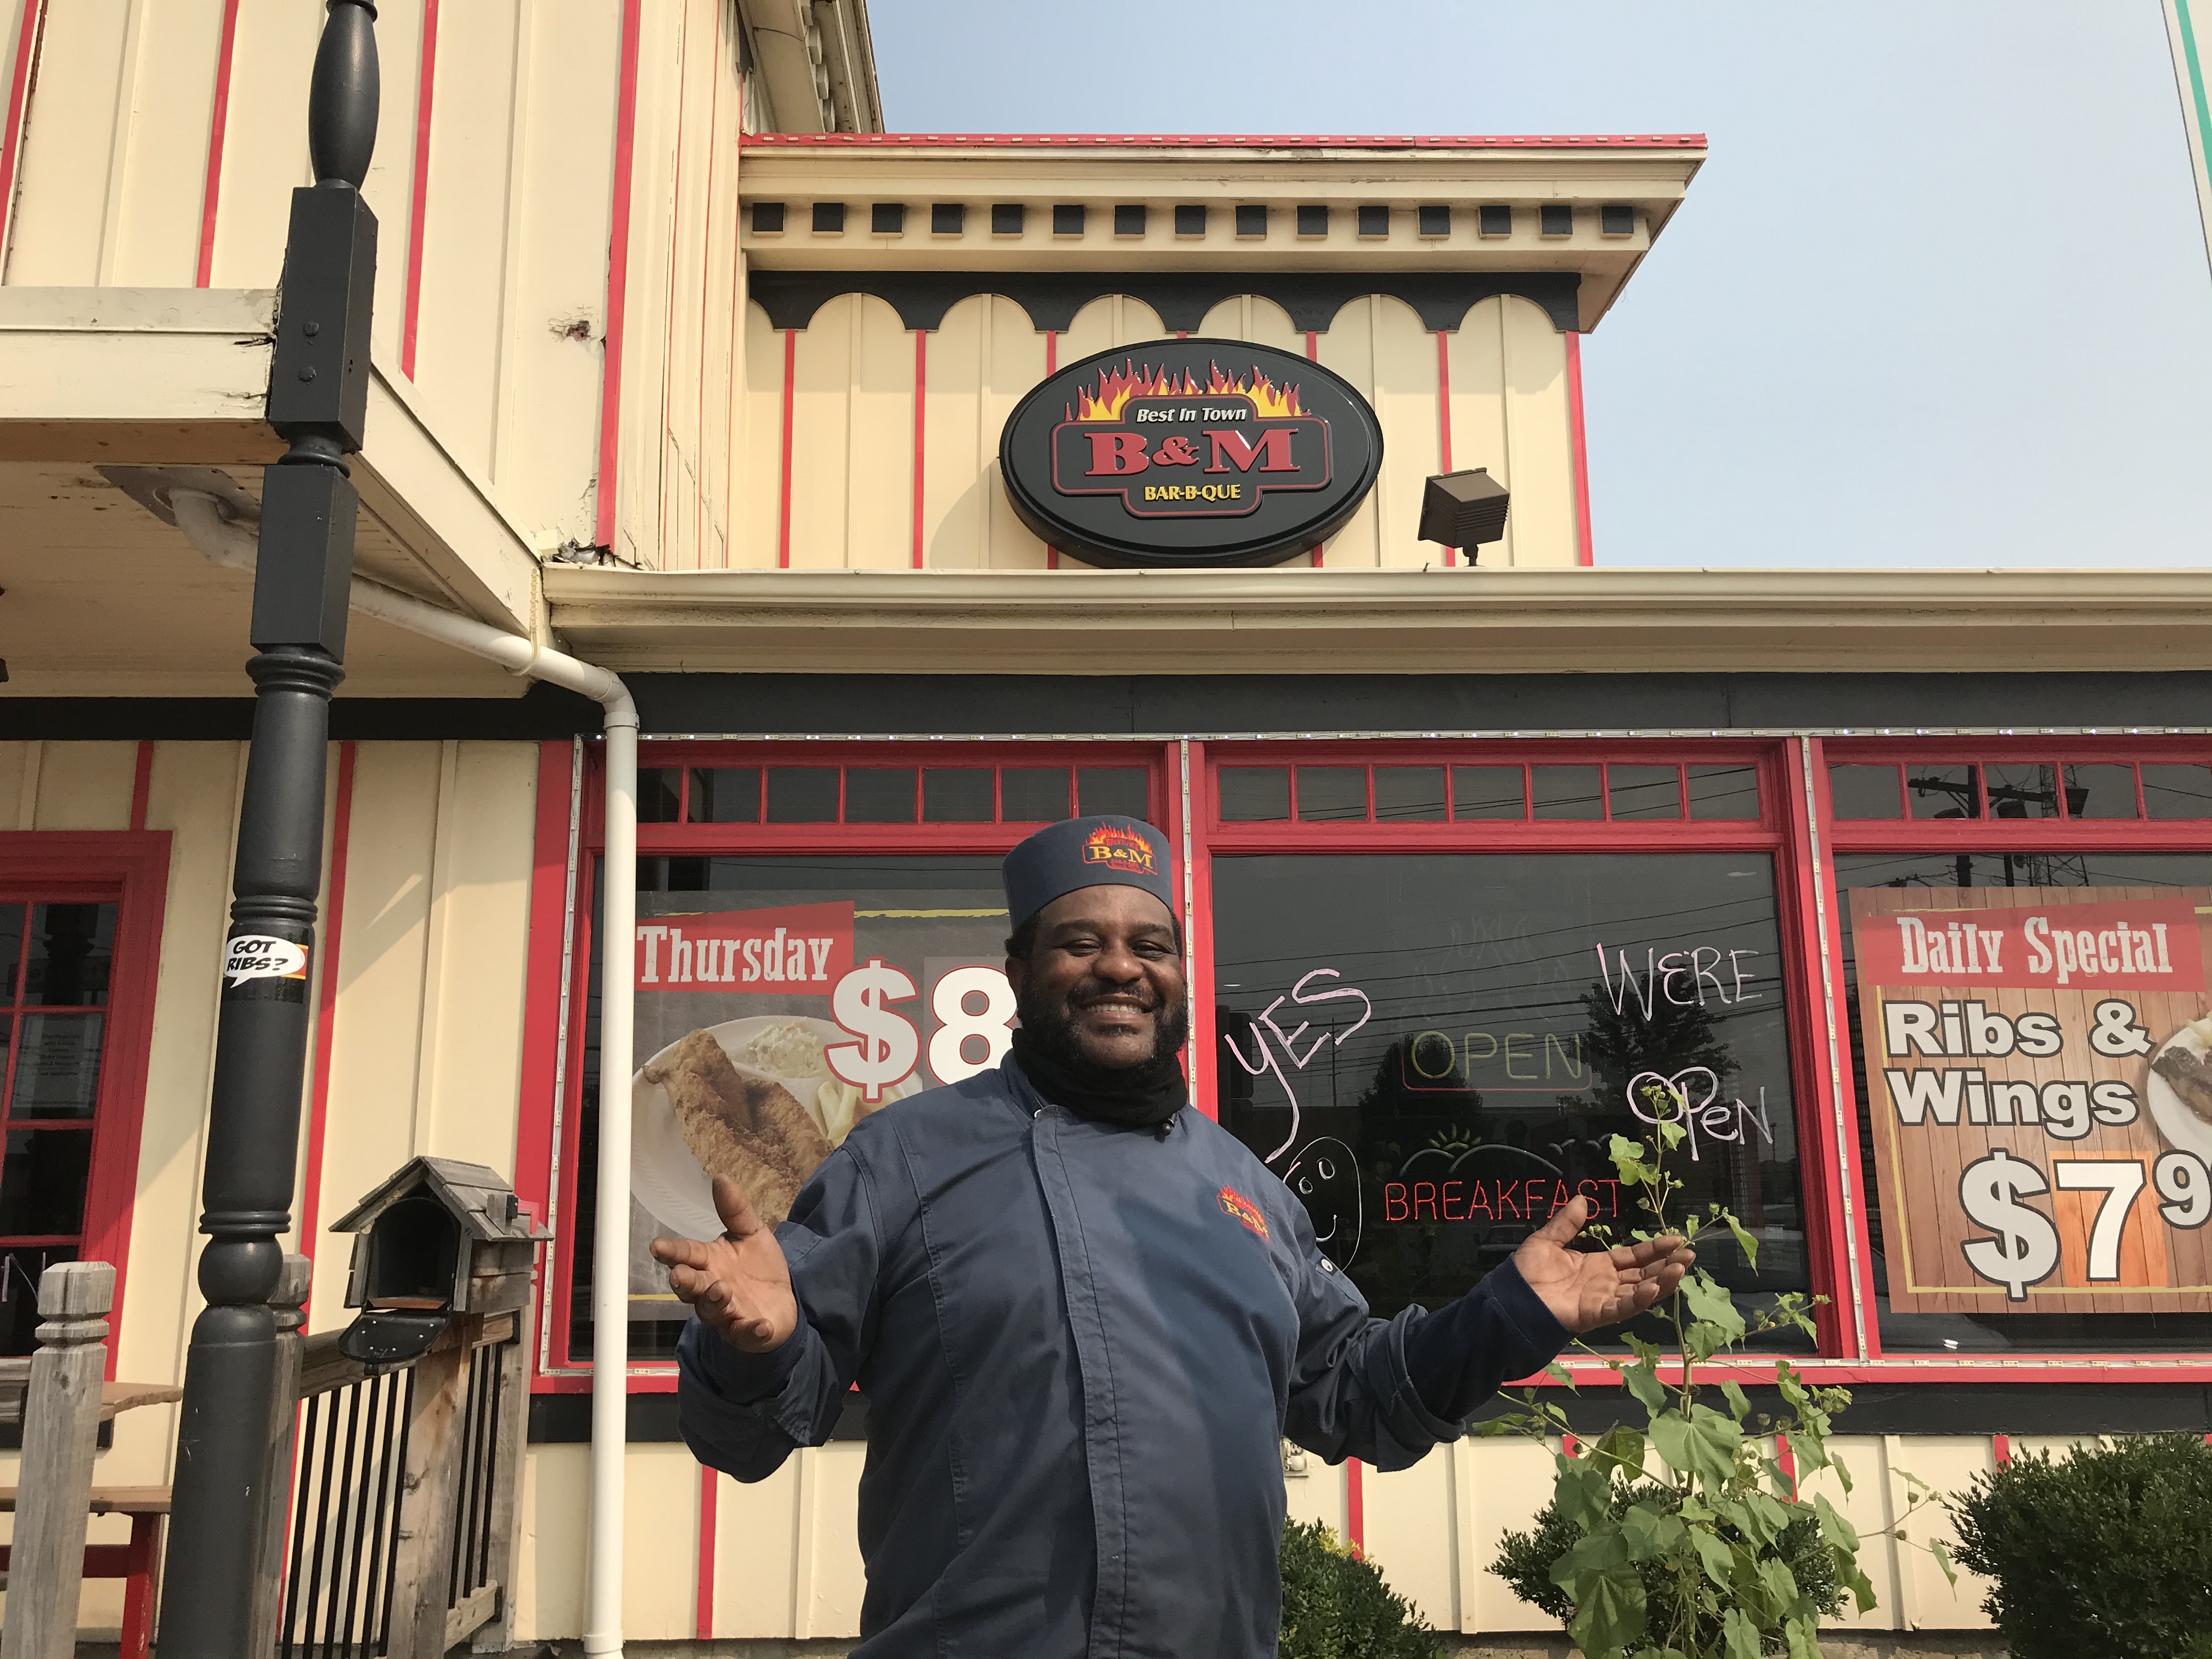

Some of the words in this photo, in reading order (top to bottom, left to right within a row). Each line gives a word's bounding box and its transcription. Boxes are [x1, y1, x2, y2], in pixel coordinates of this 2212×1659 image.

[1137, 407, 1175, 423] Best
[1178, 407, 1197, 422] In
[1201, 407, 1247, 422] Town
[1084, 428, 1301, 476] B&M
[1144, 484, 1241, 502] BAR-B-QUE
[1088, 845, 1153, 869] B&M
[227, 956, 289, 972] RIBS?
[233, 939, 276, 955] GOT
[636, 925, 834, 984] Thursday
[1897, 917, 2004, 974] Daily
[2024, 917, 2173, 984] Special
[1882, 1000, 2062, 1058] Ribs
[2089, 998, 2157, 1058] &
[1224, 968, 1372, 1164] YES
[1410, 1030, 1582, 1081] OPEN
[1882, 1067, 2139, 1141] Wings
[1385, 1178, 1621, 1222] BREAKFAST
